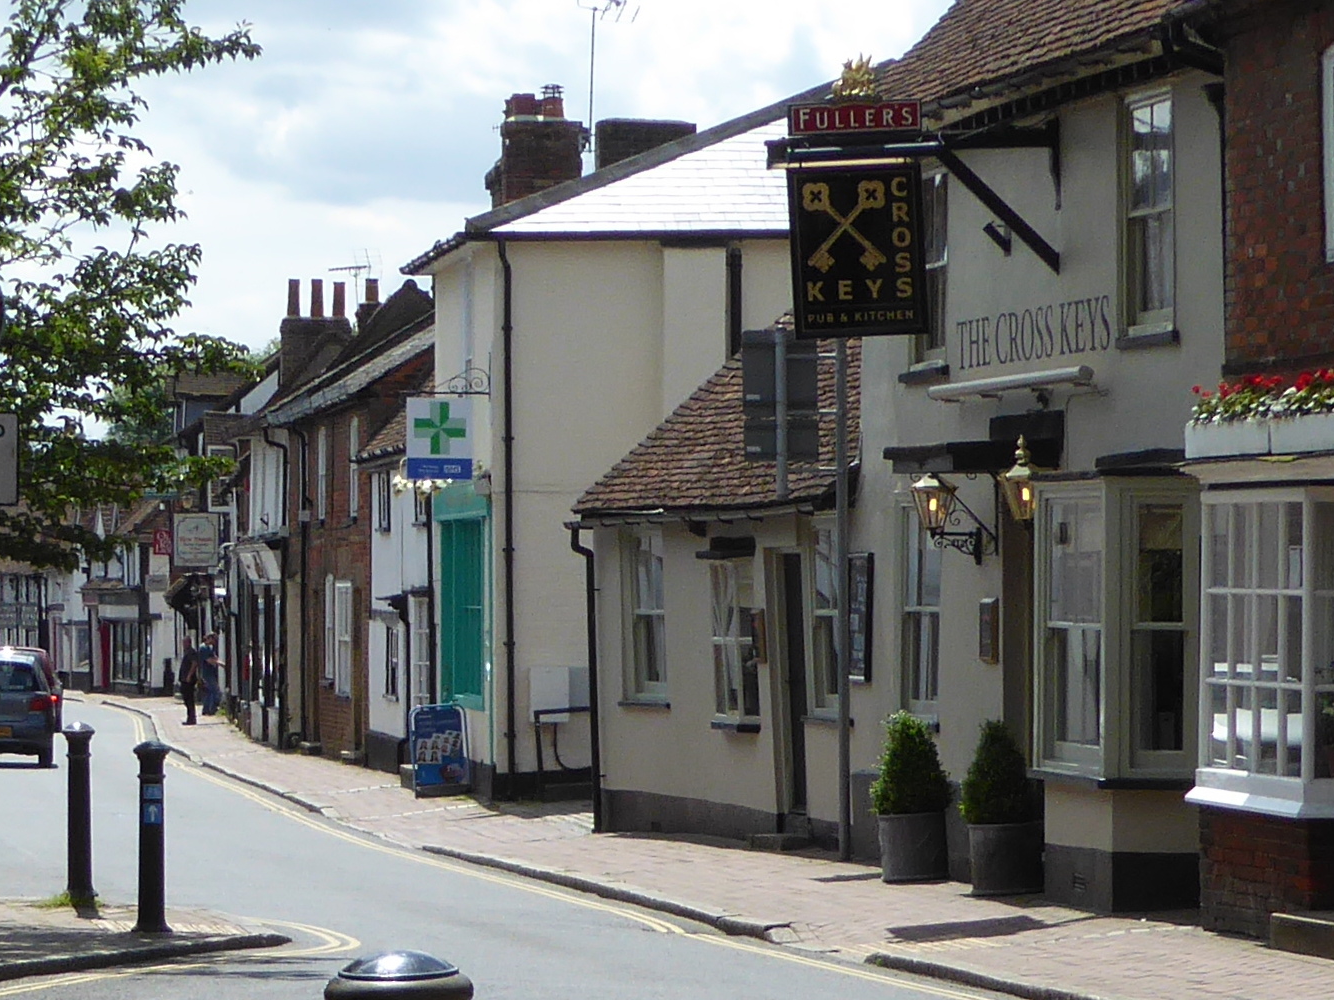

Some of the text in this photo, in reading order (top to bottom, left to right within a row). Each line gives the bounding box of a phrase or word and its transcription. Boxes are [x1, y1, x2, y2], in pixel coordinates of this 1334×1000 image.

[799, 106, 913, 130] FULLER'S
[890, 177, 913, 298] CROSS
[806, 277, 913, 302] KEYS
[807, 309, 914, 324] PUB & KITCHEN
[956, 295, 1111, 370] THE CROSS KEYS
